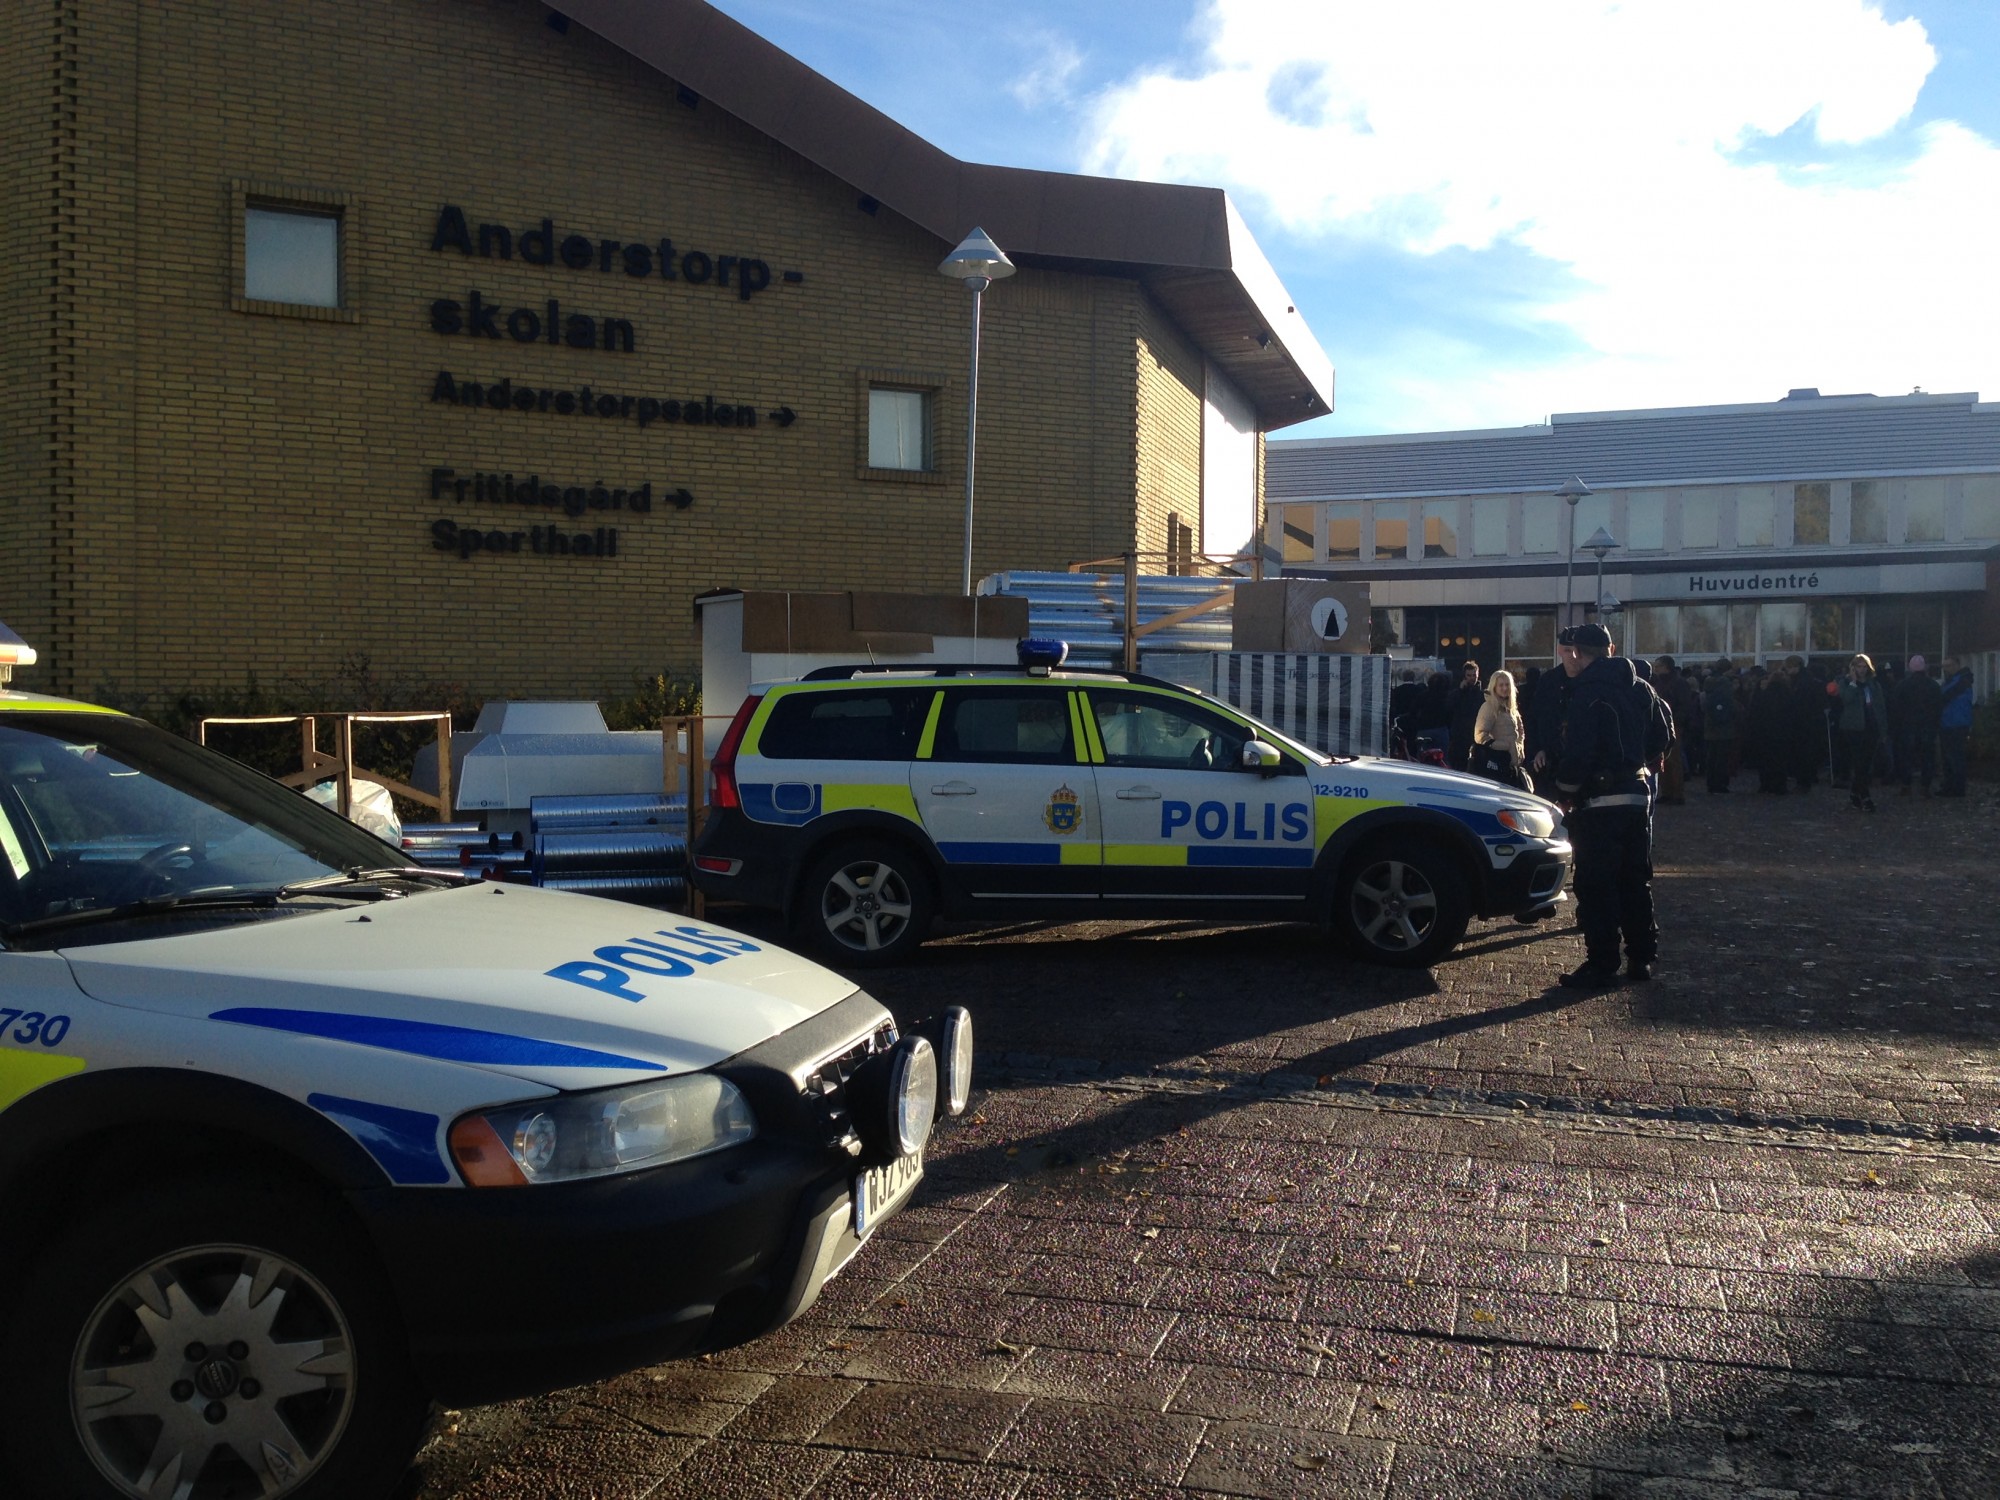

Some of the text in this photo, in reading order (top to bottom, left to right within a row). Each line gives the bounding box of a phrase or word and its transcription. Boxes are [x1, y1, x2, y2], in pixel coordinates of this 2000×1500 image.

[431, 290, 635, 353] skolan
[431, 371, 757, 428] Anderstorpsalen
[431, 469, 651, 517] Fritidsgård
[431, 519, 618, 560] Sporthall
[1689, 572, 1819, 591] Huvudentré
[1313, 784, 1369, 799] 12-9210
[1161, 800, 1309, 842] POLIS
[543, 926, 762, 1003] POLIS
